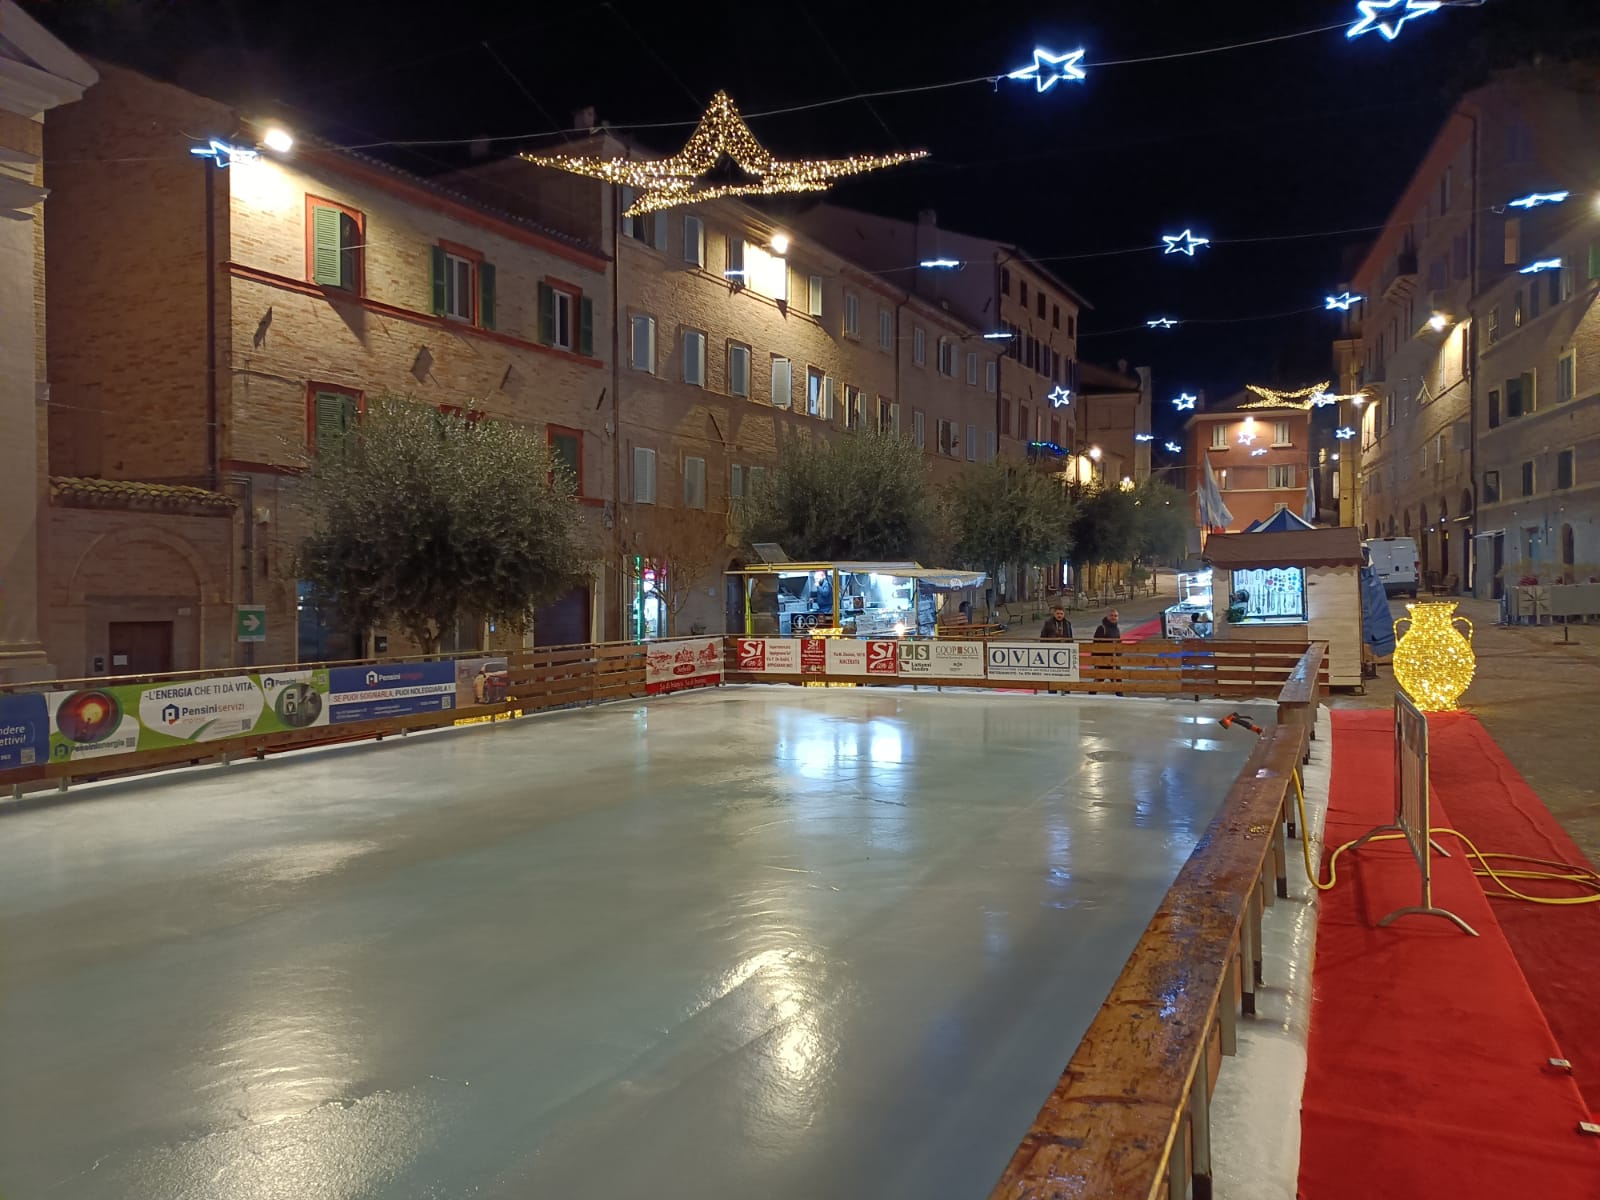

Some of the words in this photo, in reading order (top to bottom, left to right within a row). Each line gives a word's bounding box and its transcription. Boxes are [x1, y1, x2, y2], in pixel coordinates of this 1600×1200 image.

[992, 650, 1066, 666] OVAC
[194, 686, 213, 696] CHE
[213, 685, 221, 694] TI
[222, 682, 234, 693] DÀ
